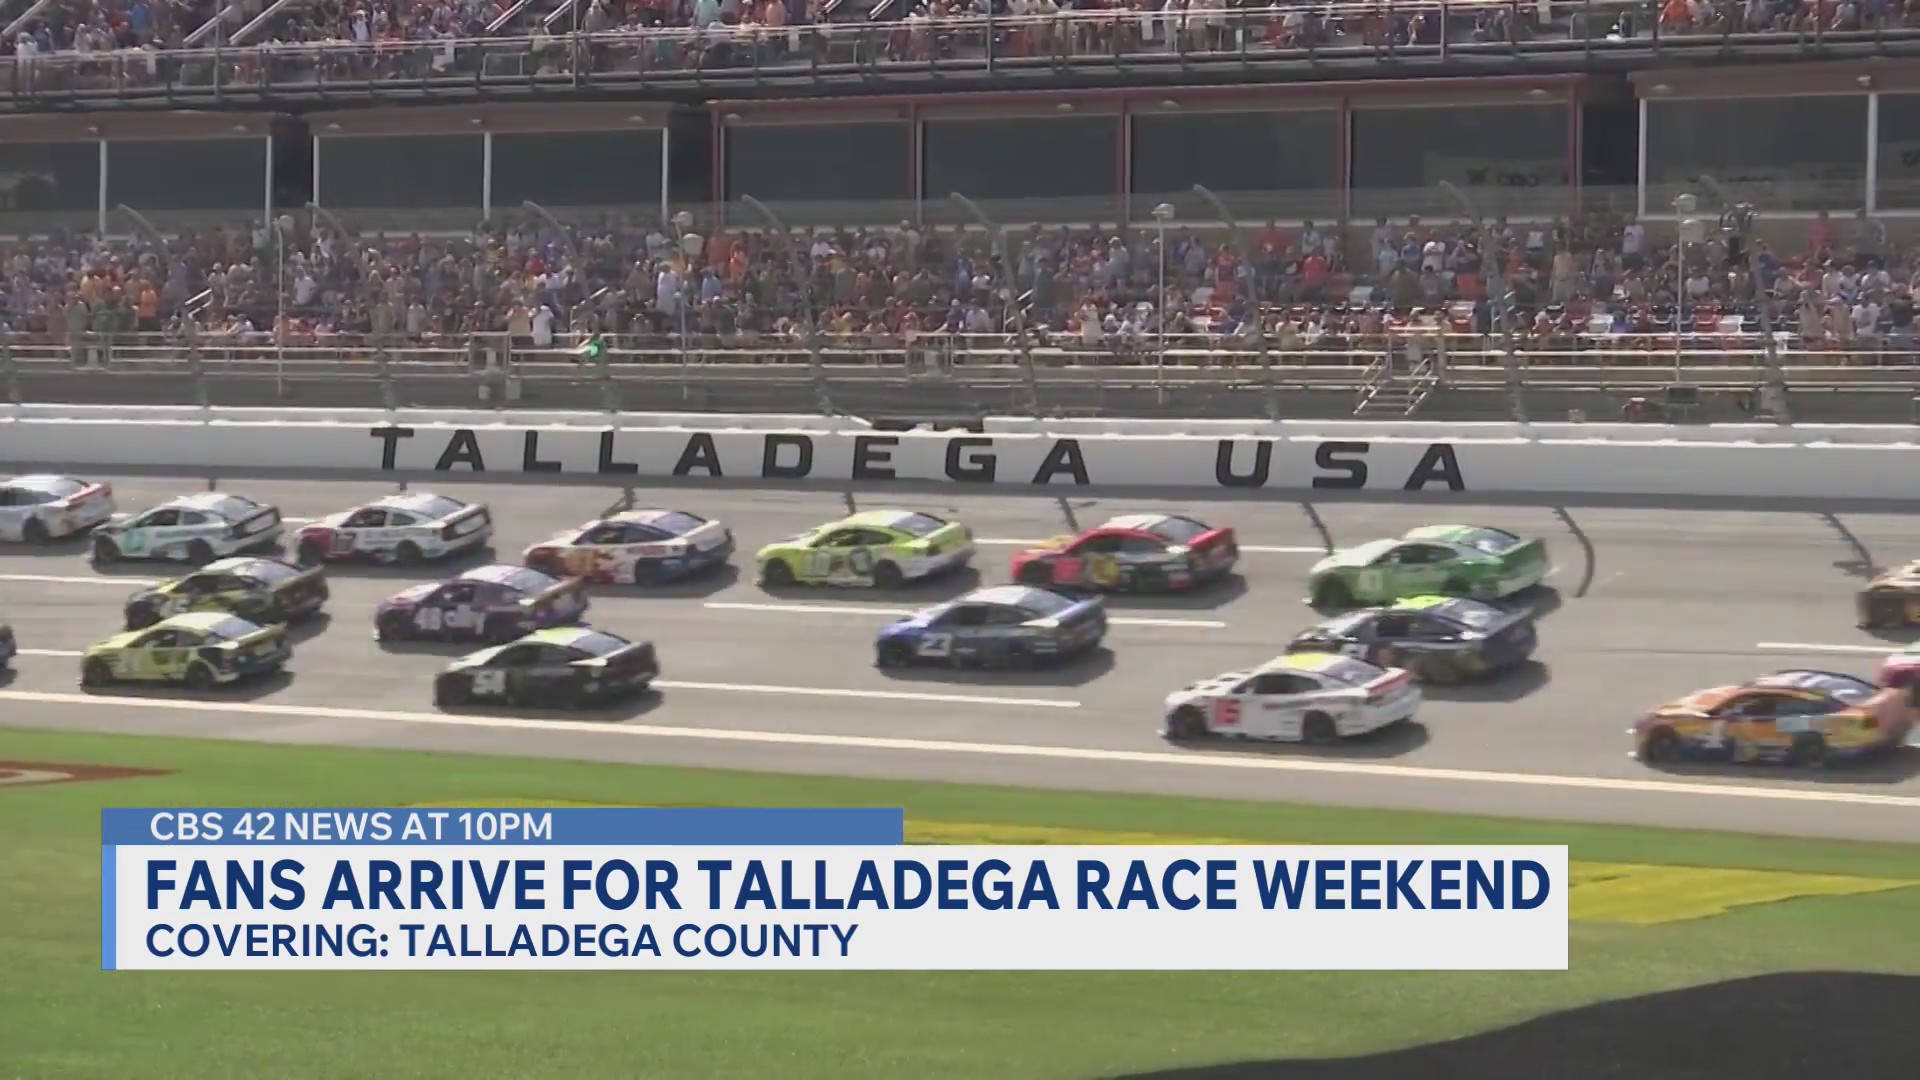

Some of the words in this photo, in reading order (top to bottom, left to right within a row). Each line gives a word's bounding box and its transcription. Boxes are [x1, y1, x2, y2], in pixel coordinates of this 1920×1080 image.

[371, 427, 1090, 485] TALLADEGA
[1215, 440, 1465, 491] USA
[918, 632, 954, 657] 23
